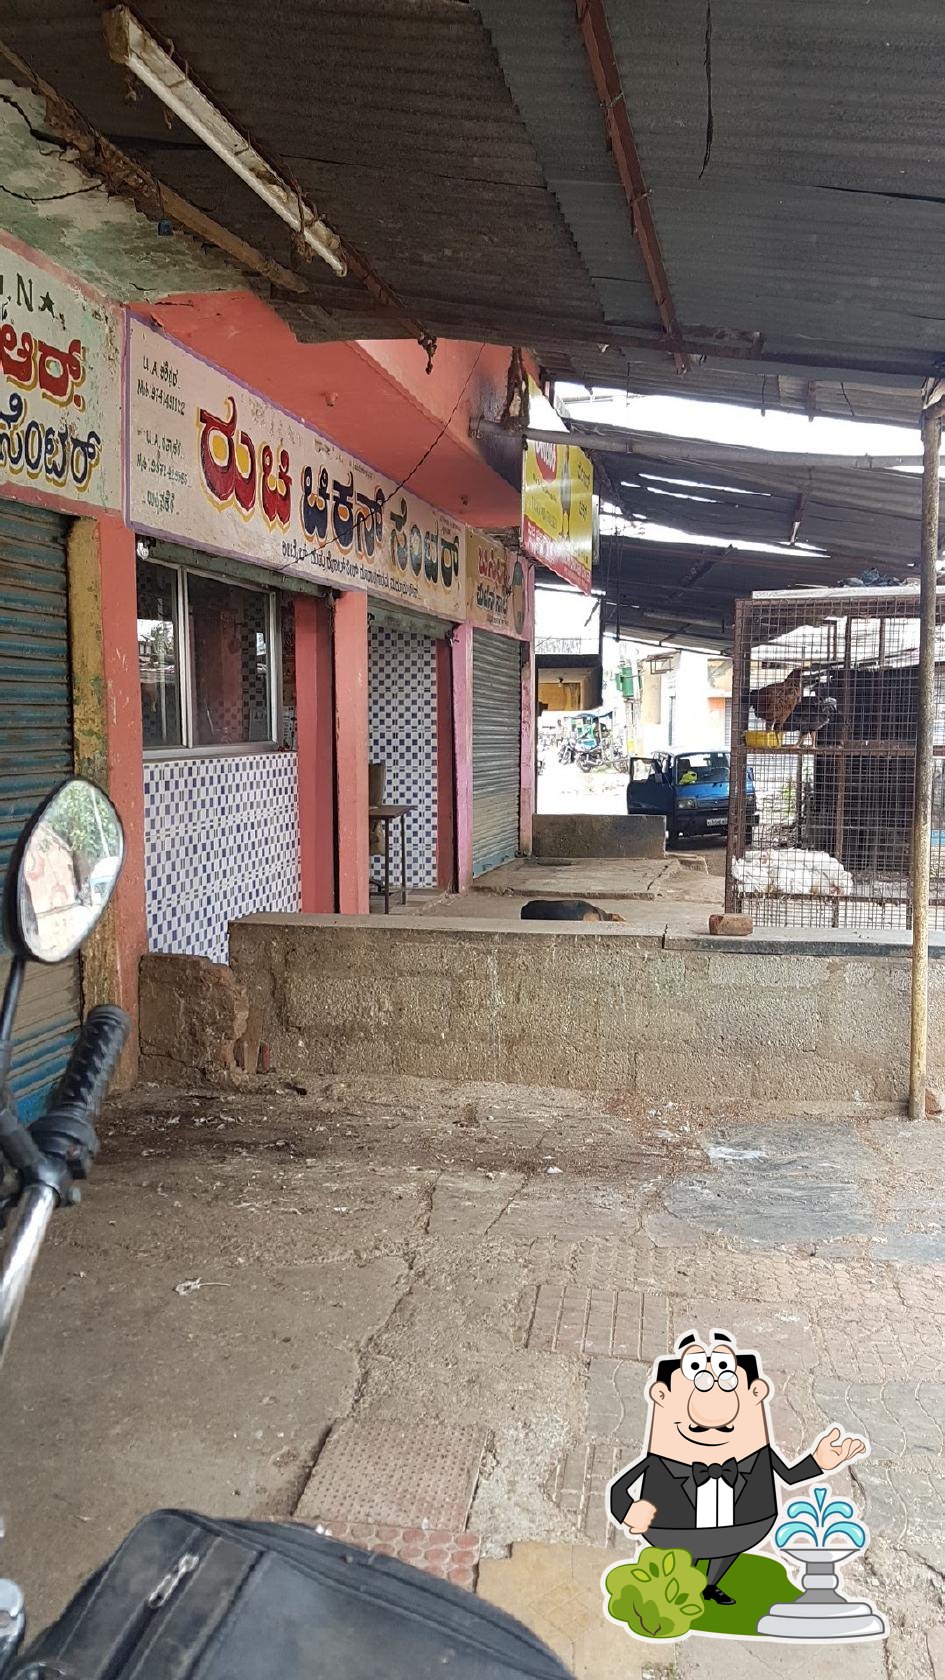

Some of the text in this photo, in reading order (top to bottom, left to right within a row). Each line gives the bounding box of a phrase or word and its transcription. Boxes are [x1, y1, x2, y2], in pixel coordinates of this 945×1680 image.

[198, 396, 292, 528] ರುಚಿ
[301, 465, 385, 558] ಚಿಕನ್
[389, 497, 460, 588] ಸೆಂಟರ್
